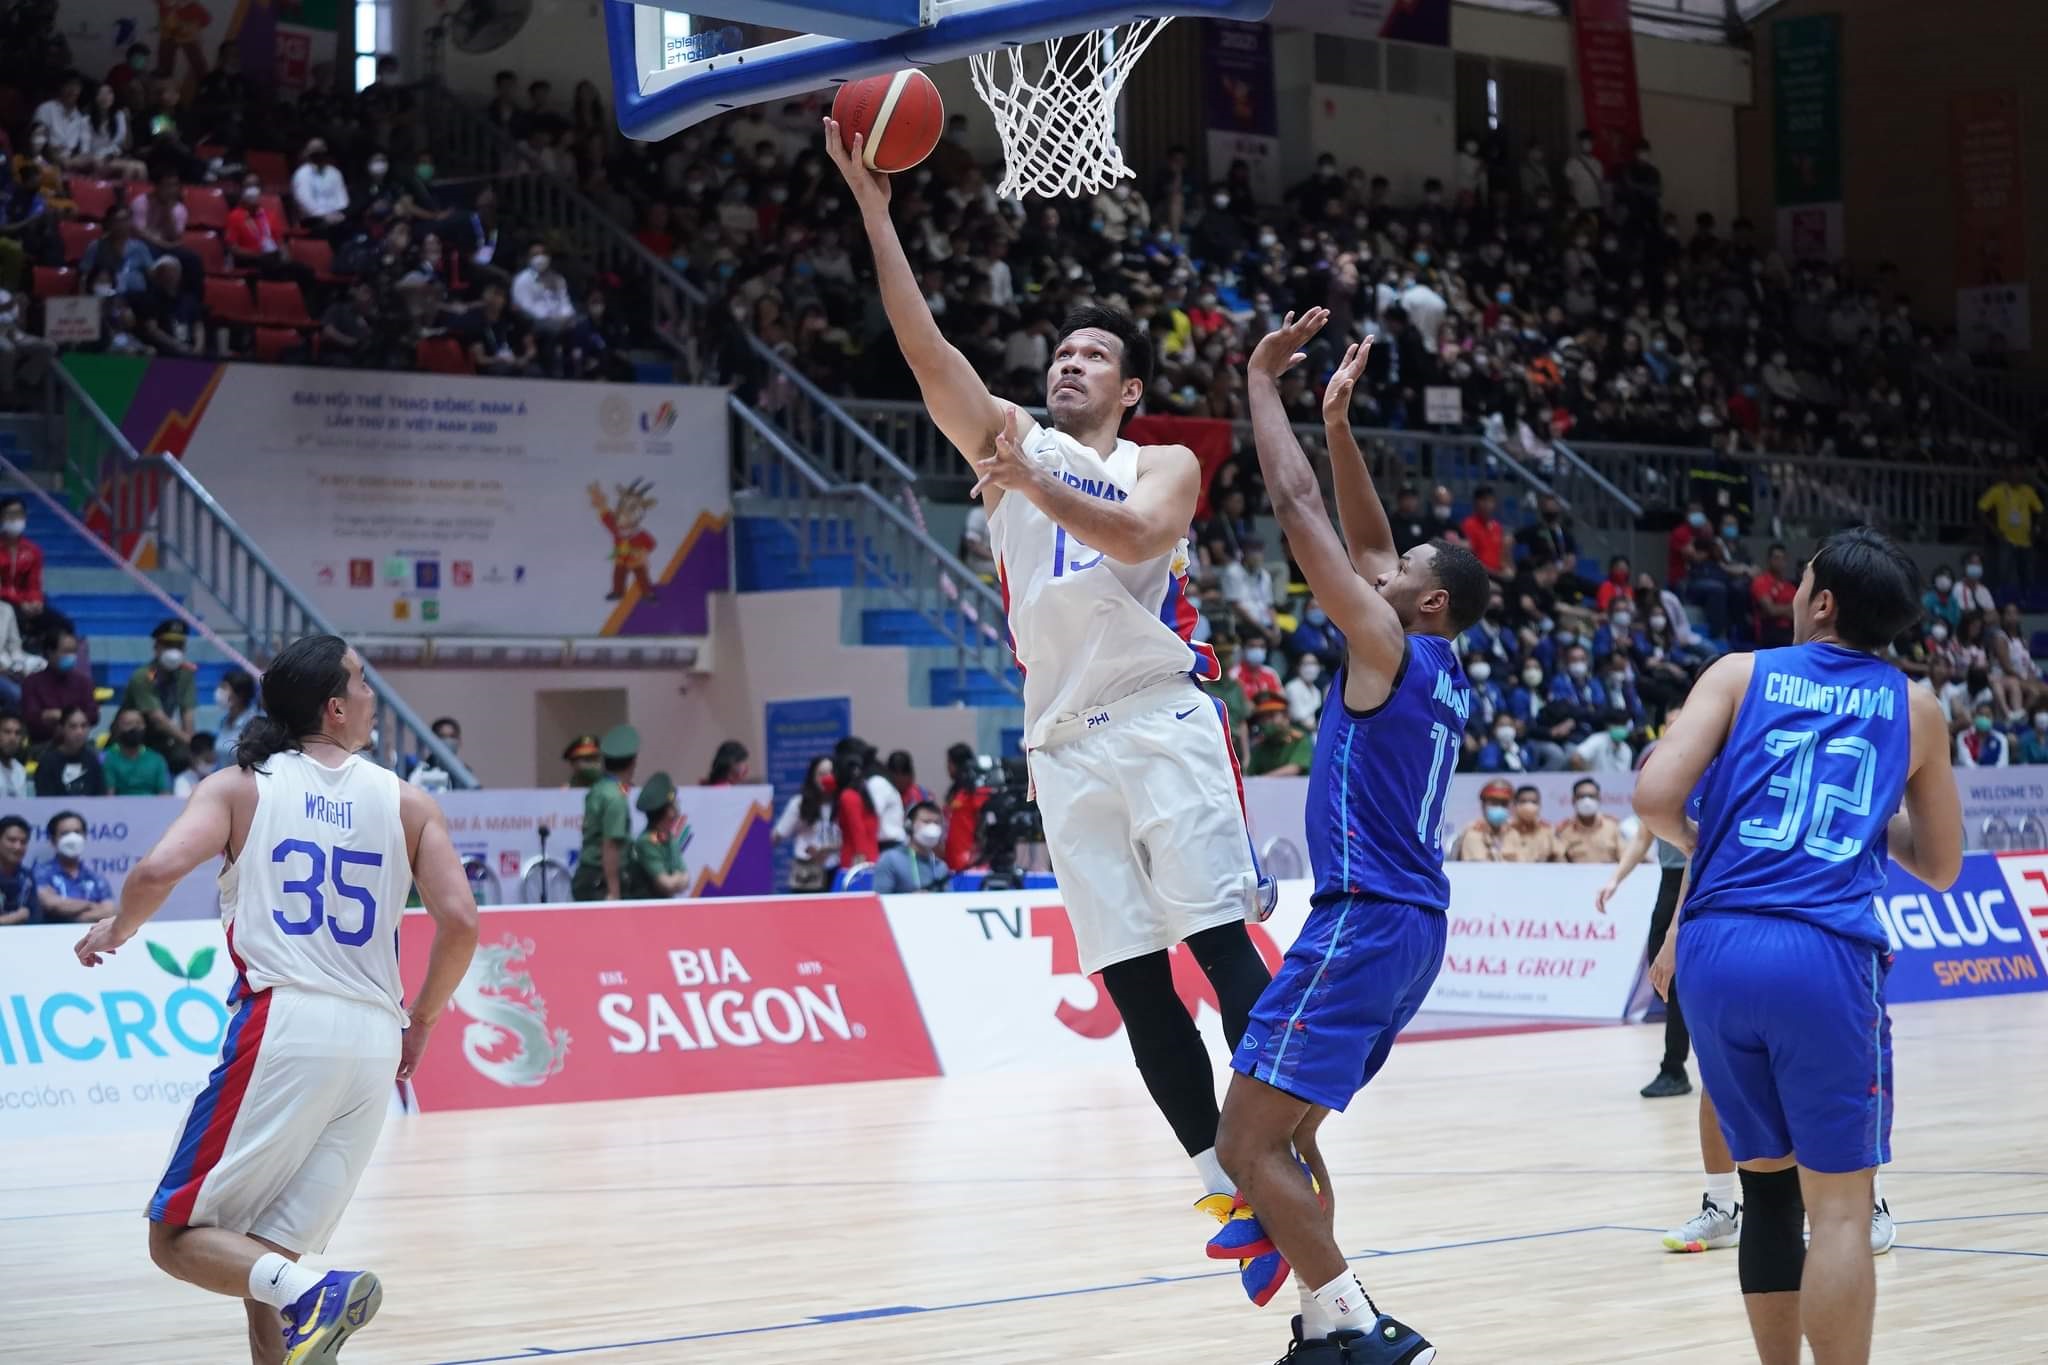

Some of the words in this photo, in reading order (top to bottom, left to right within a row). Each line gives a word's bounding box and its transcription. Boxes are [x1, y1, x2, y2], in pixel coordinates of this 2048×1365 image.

[480, 402, 514, 416] NAM
[1087, 711, 1110, 729] PHI
[1738, 728, 1877, 863] 32
[1970, 784, 2025, 800] WELCOME
[2028, 784, 2044, 800] TO
[305, 791, 353, 829] WRIGHT
[86, 822, 128, 841] HAO
[272, 838, 383, 947] 35
[966, 907, 1021, 940] TV
[1516, 919, 1617, 940] HANAKA
[668, 947, 751, 986] BIA
[1445, 955, 1508, 976] NAKA
[1517, 957, 1596, 979] GROUP
[1933, 955, 2037, 986] SPORT.VN
[597, 984, 852, 1053] SAIGON
[87, 1081, 120, 1105] de
